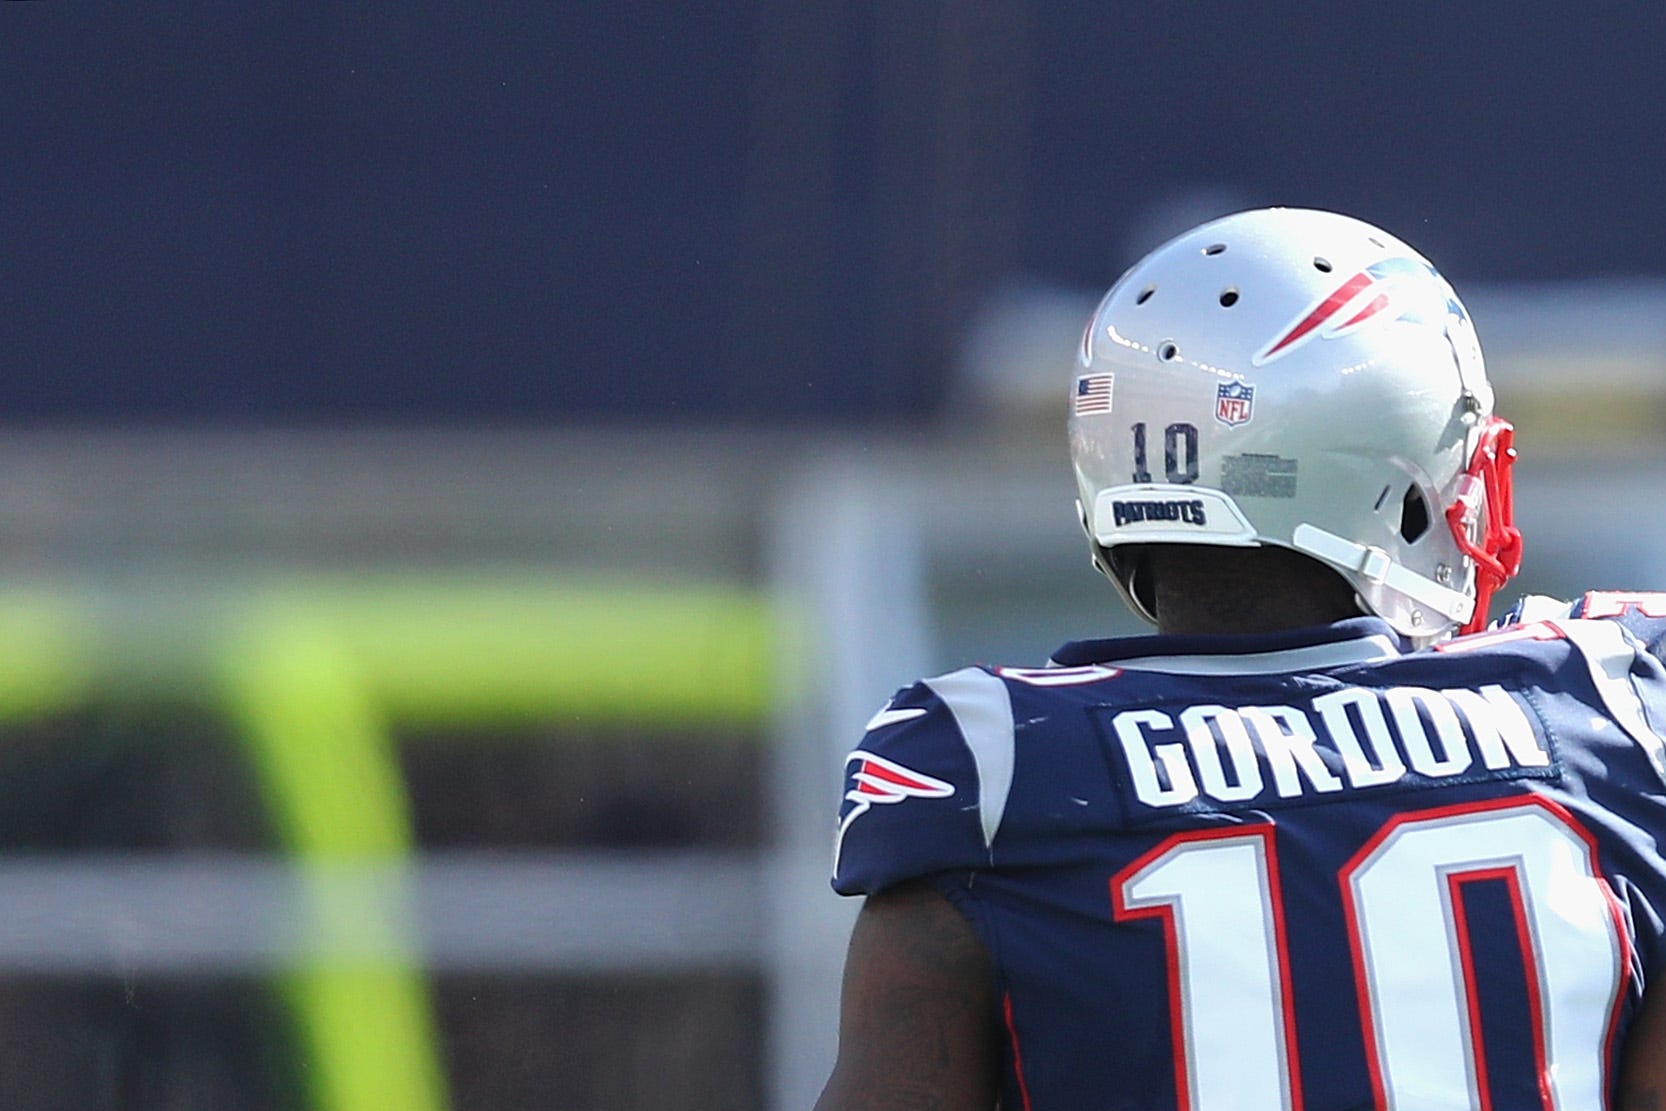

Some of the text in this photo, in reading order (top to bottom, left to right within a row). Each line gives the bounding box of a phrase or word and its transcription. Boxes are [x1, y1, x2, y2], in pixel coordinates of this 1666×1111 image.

[1219, 399, 1248, 421] NFL
[1131, 422, 1199, 483] 10
[1112, 500, 1206, 527] PATRIOTS
[1113, 685, 1549, 808] GORDON
